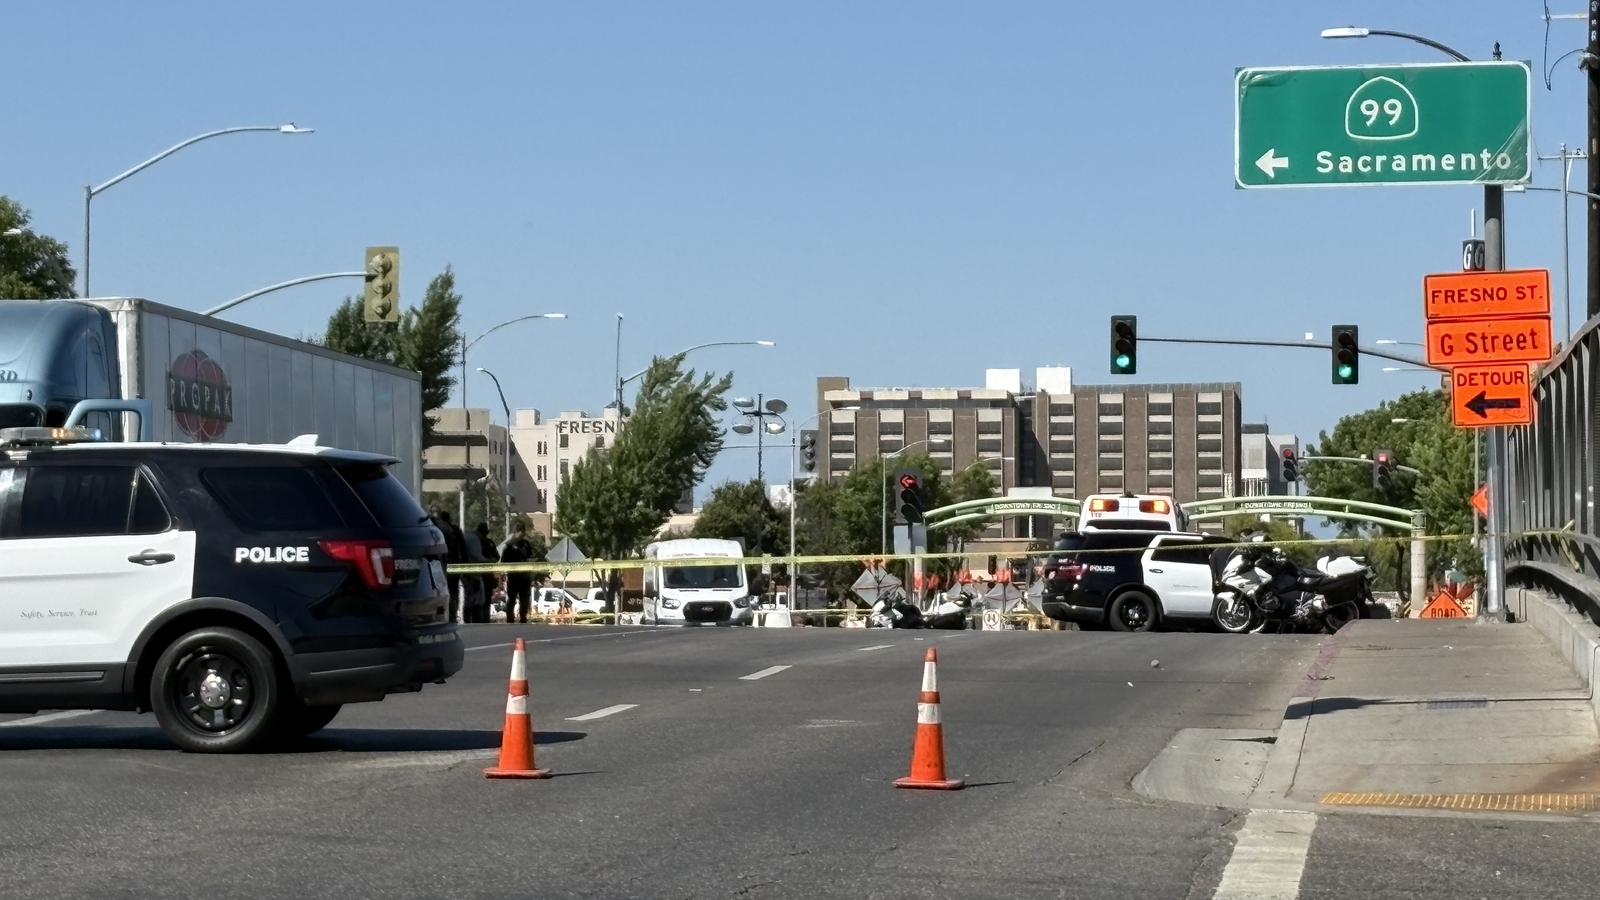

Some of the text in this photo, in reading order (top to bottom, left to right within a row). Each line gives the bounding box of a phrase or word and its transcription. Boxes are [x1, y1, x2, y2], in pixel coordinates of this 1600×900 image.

[1360, 99, 1402, 126] 99
[1316, 148, 1511, 173] Sacramento
[1431, 285, 1543, 304] FRESNO ST.
[1440, 328, 1539, 356] G Street
[1457, 371, 1525, 387] DETOUR
[170, 378, 232, 416] PROPAK
[235, 546, 310, 563] POLICE
